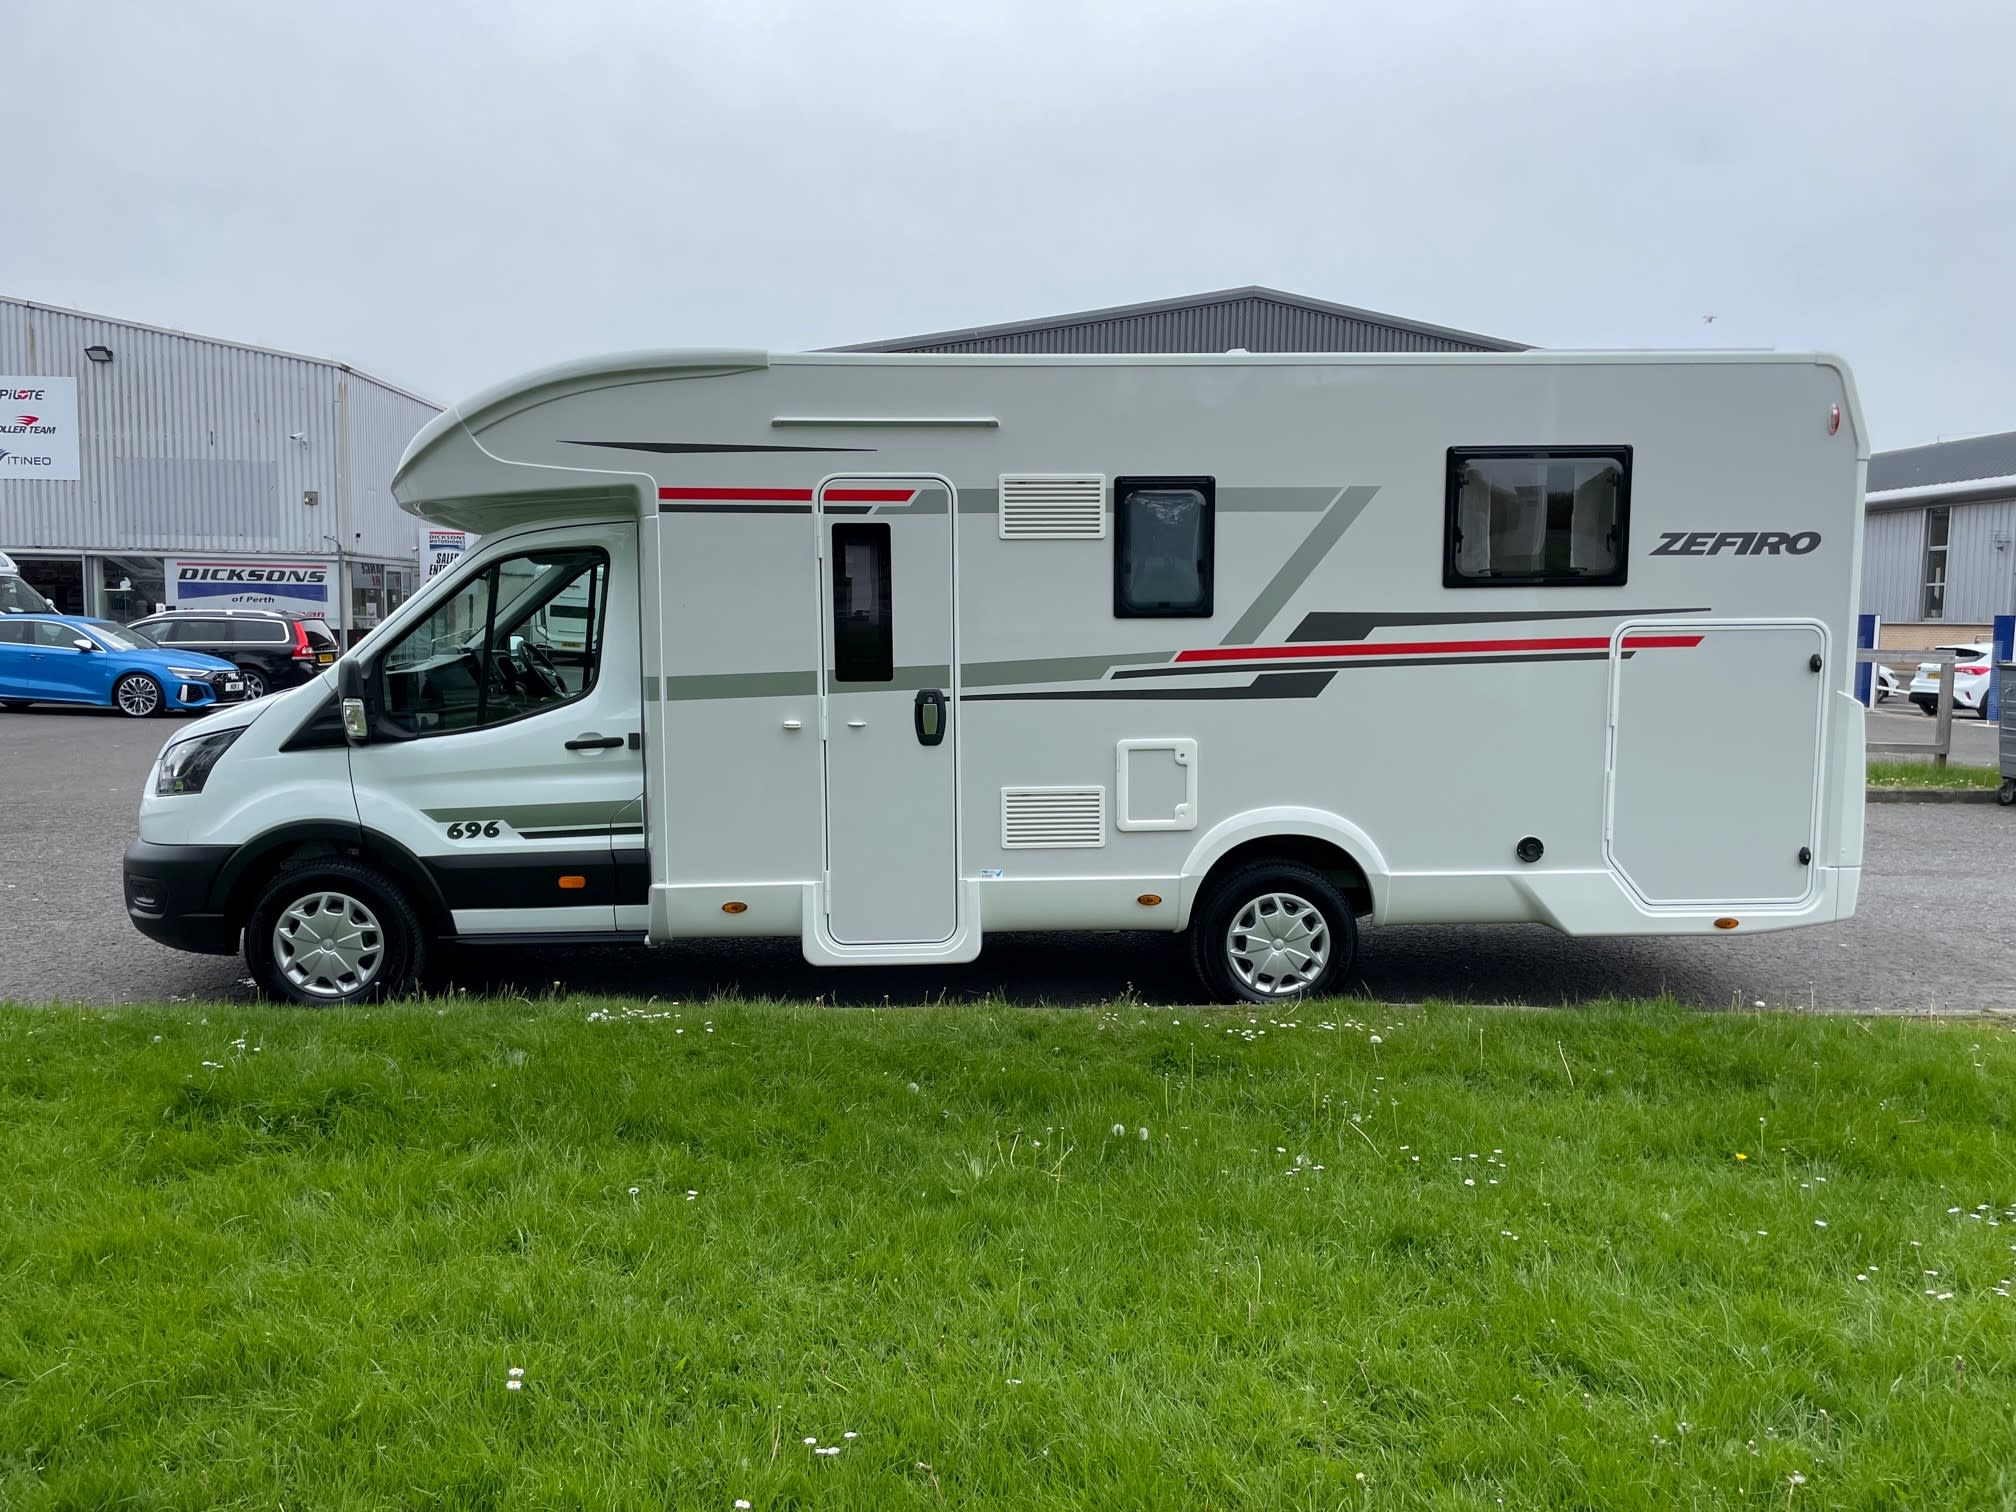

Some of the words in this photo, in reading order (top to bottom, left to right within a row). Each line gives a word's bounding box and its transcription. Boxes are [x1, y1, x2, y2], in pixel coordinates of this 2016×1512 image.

[29, 426, 57, 435] TEAM
[7, 456, 52, 466] ITINEO
[1648, 531, 1823, 556] ZEFIRO
[178, 568, 327, 583] DICKSONS
[246, 596, 276, 604] Perth
[446, 821, 500, 840] 696
